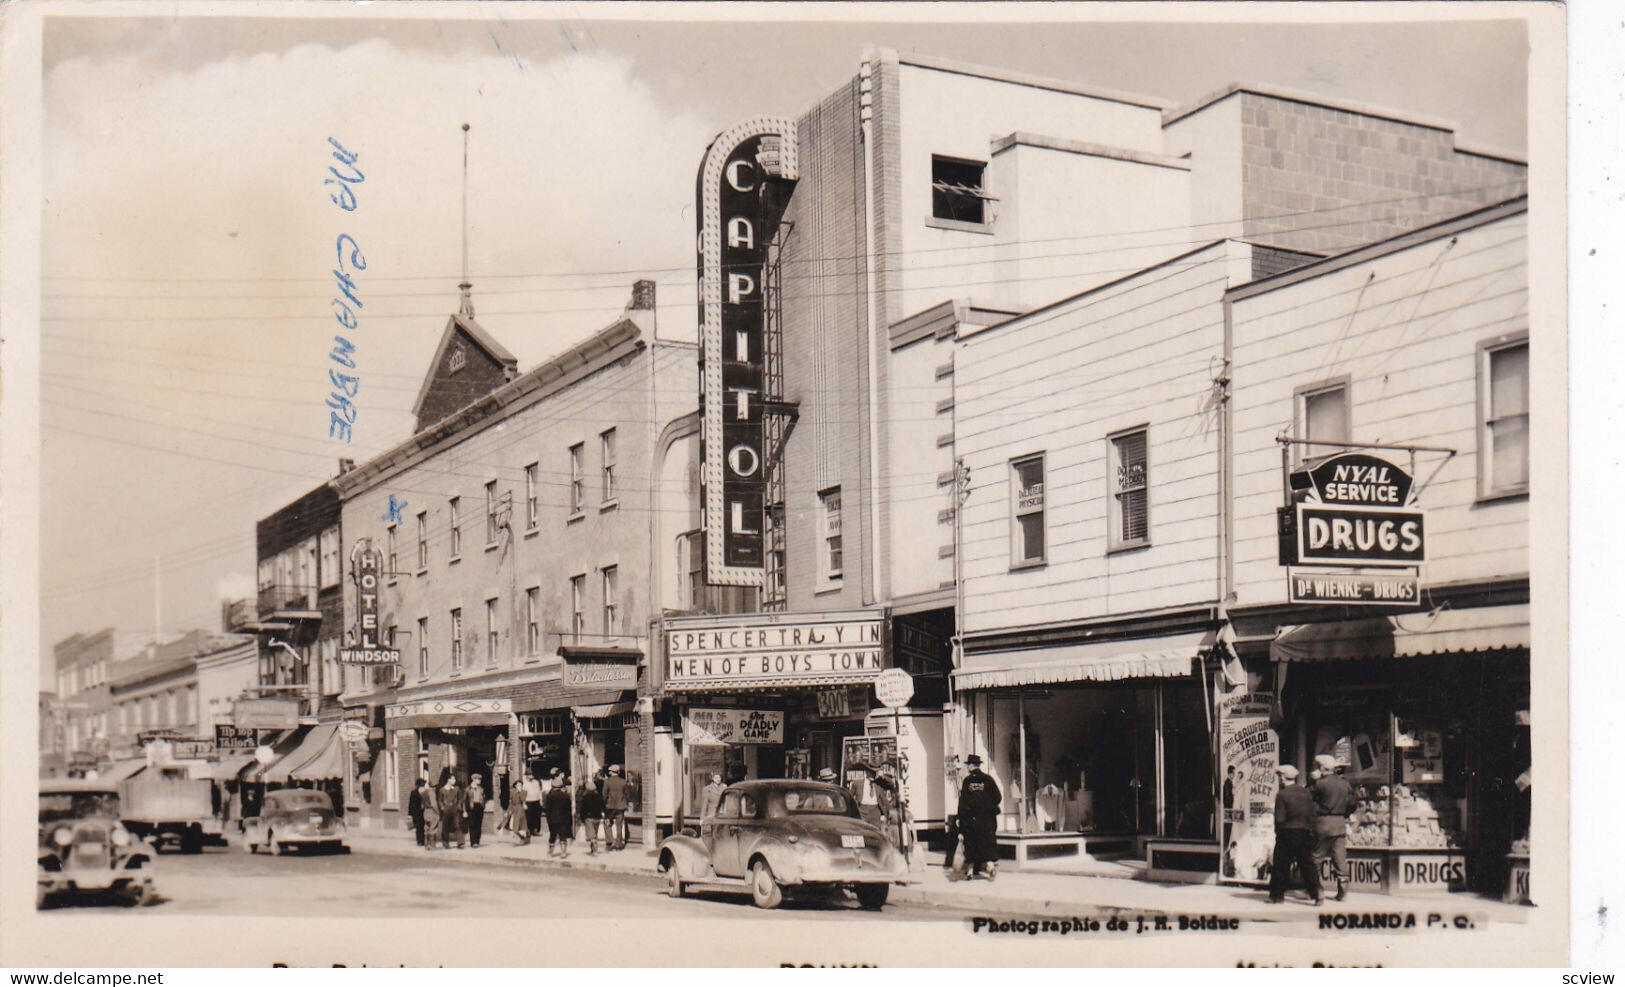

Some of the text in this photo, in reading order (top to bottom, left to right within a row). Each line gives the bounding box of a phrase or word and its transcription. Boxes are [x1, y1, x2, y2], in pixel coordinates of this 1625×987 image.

[326, 233, 368, 445] CHAMBRE
[726, 159, 760, 535] CAPITOL
[1333, 465, 1391, 484] NYAL
[1325, 483, 1399, 502] SERVICE
[1308, 517, 1421, 552] DRUGS
[1314, 580, 1362, 598] WIENKE
[1374, 582, 1413, 599] DRUGS
[361, 554, 377, 649] HOTEL
[672, 629, 767, 651] SPENCER
[860, 622, 880, 643] IN
[340, 651, 400, 662] WINDSOR
[674, 652, 880, 677] MEN OF BOYS TOWN
[694, 711, 713, 720] MEN
[740, 720, 779, 730] DEADLY
[744, 729, 769, 738] GAME
[1234, 720, 1270, 743] CRAWFOR
[1240, 731, 1269, 751] TAYLOR
[1250, 784, 1273, 797] MEET
[1404, 862, 1465, 884] DRUGS
